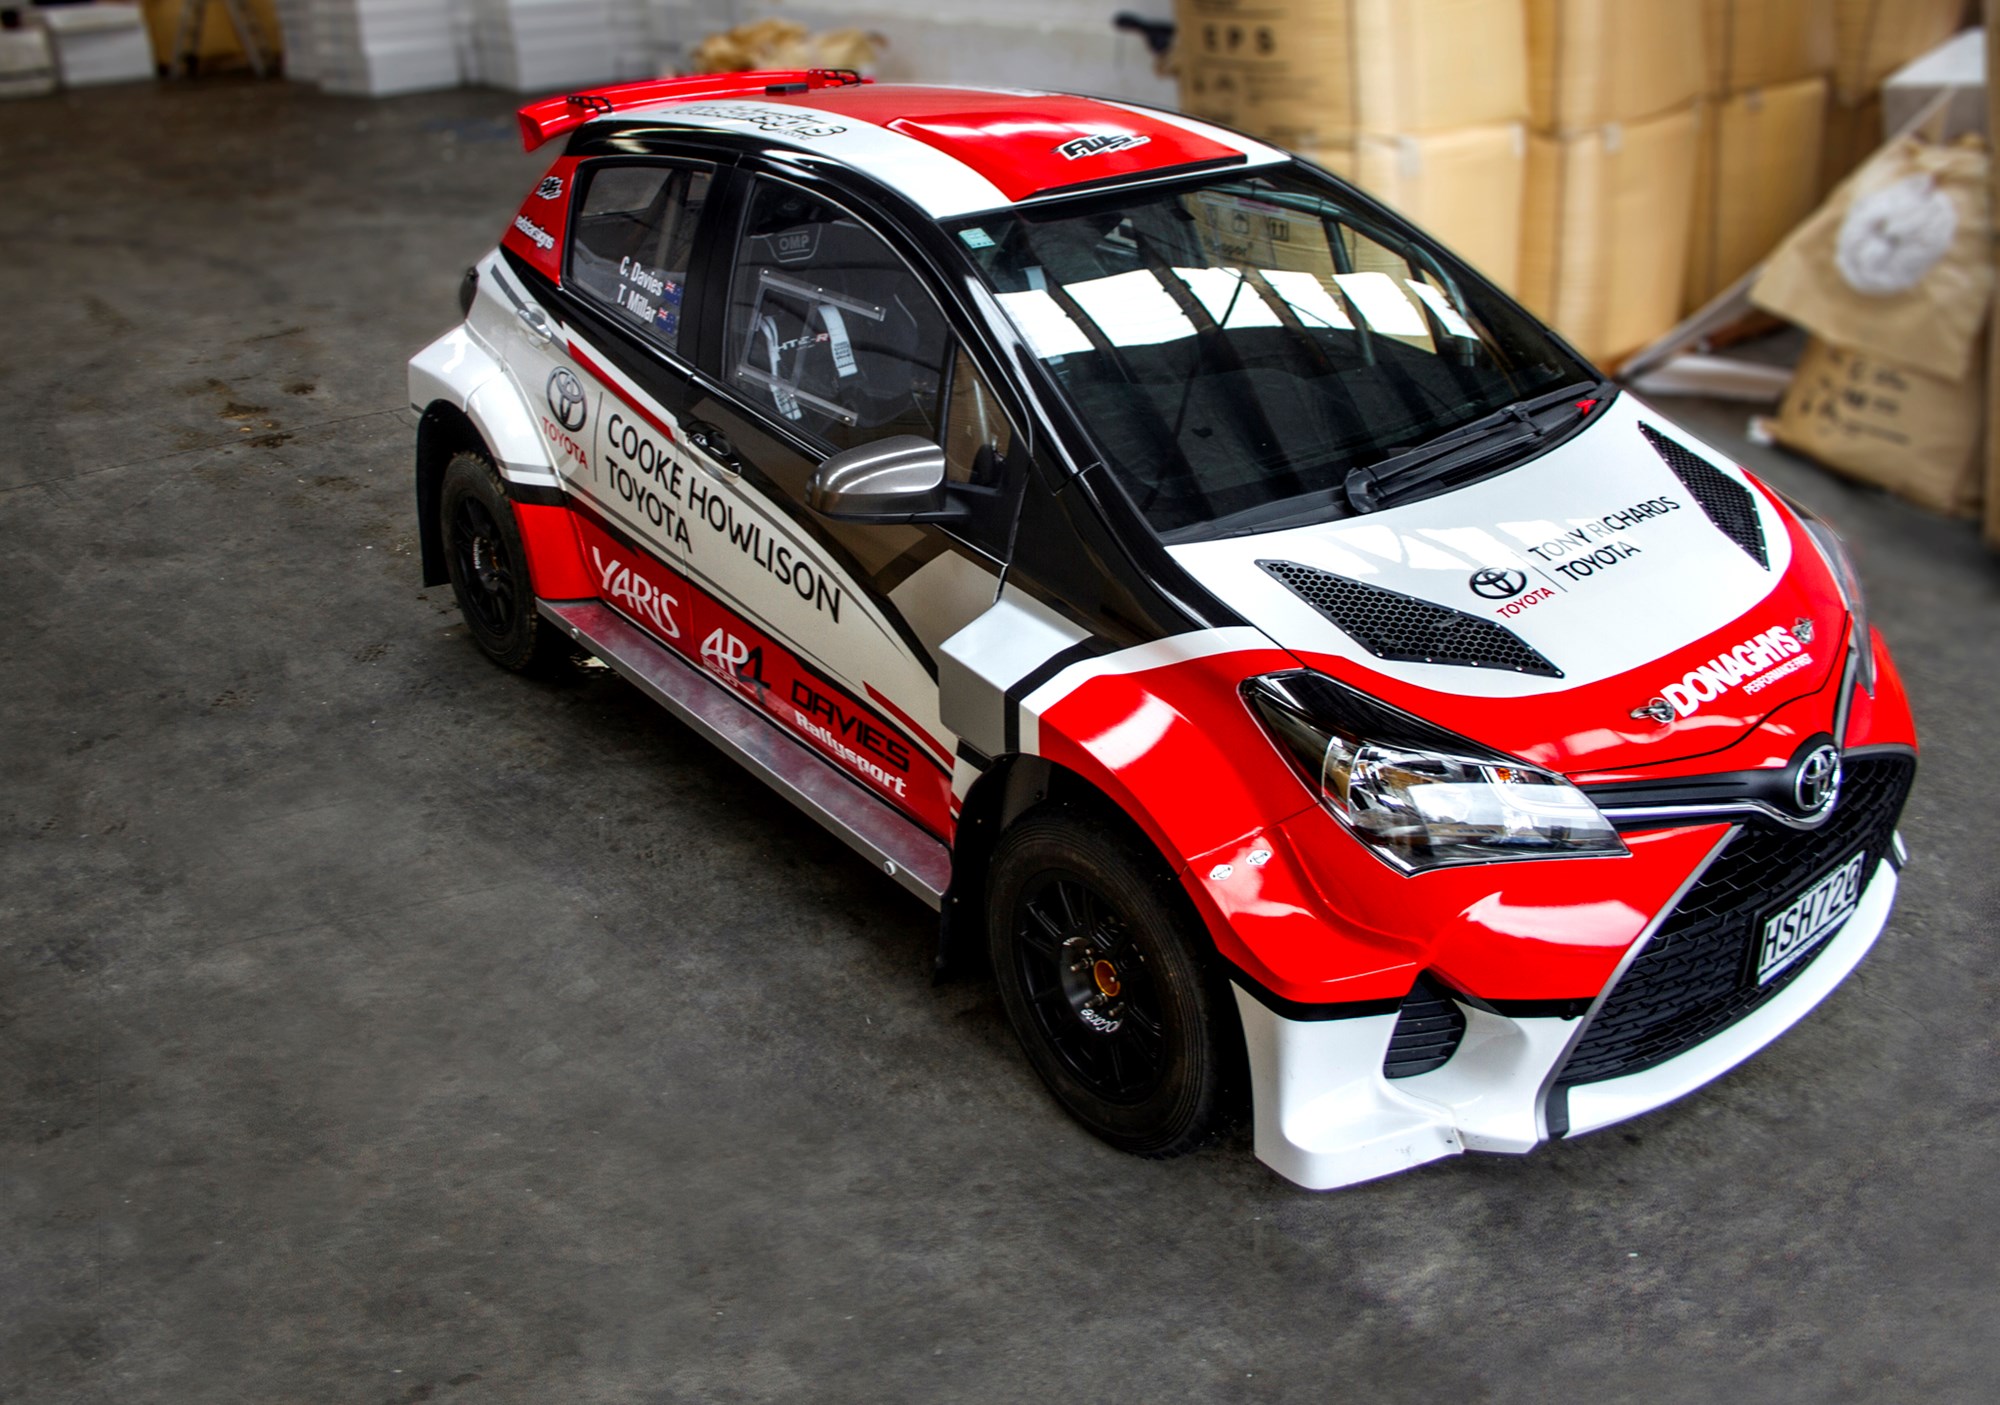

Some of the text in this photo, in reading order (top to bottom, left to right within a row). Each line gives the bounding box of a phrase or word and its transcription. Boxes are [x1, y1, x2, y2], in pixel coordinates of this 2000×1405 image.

[779, 234, 810, 250] OMP
[617, 283, 657, 323] T. Millar
[620, 256, 664, 296] C. Davies
[542, 416, 589, 470] TOYOTA
[605, 455, 693, 554] TOYOTA
[608, 414, 841, 624] COOKE HOWLISON
[1528, 496, 1680, 561] TONY RICHARDS
[1555, 540, 1642, 581] TOYOTA
[1496, 587, 1555, 619] TOYOTA
[1660, 625, 1802, 717] DONAGHYS
[791, 679, 909, 773] DAVIES
[794, 709, 907, 798] Rallysport
